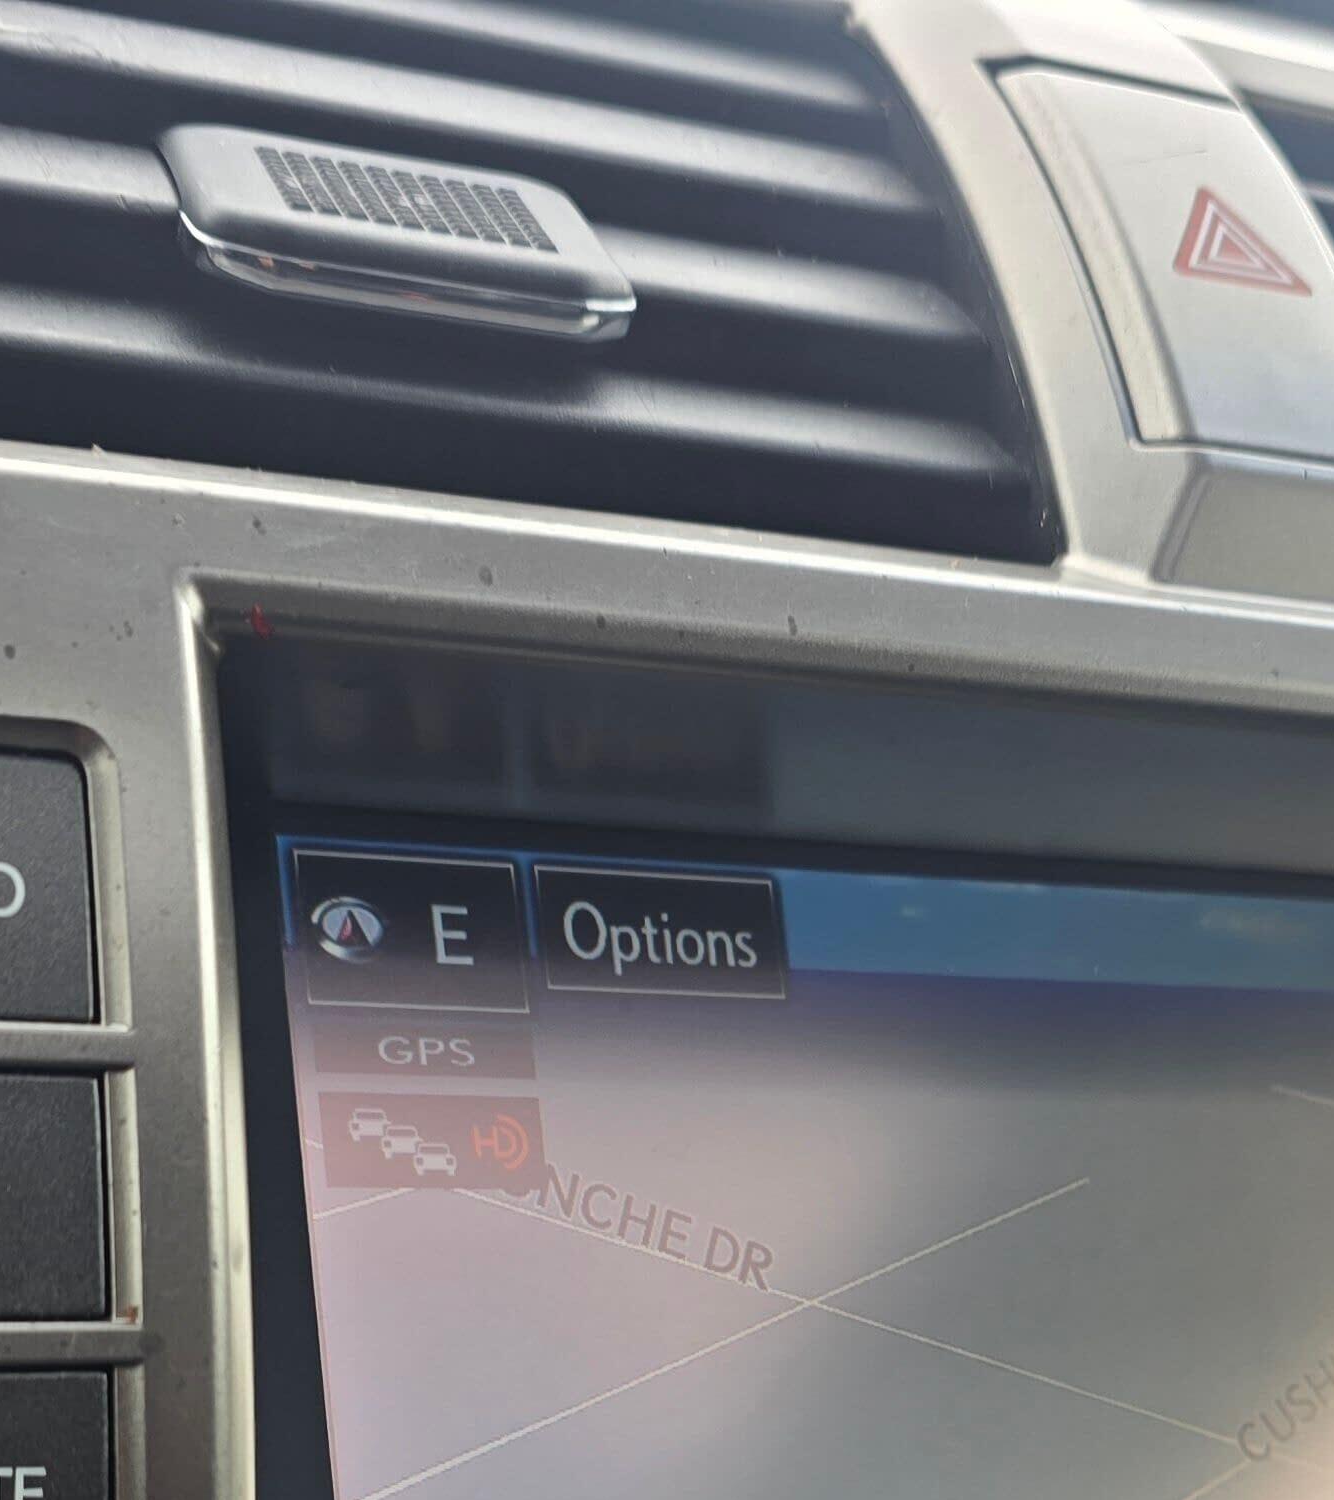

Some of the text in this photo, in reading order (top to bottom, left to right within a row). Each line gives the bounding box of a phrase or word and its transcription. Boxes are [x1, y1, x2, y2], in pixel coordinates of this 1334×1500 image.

[430, 904, 475, 965] E
[563, 900, 758, 976] Options
[378, 1036, 475, 1066] GPS
[517, 1163, 774, 1291] NCHE DR
